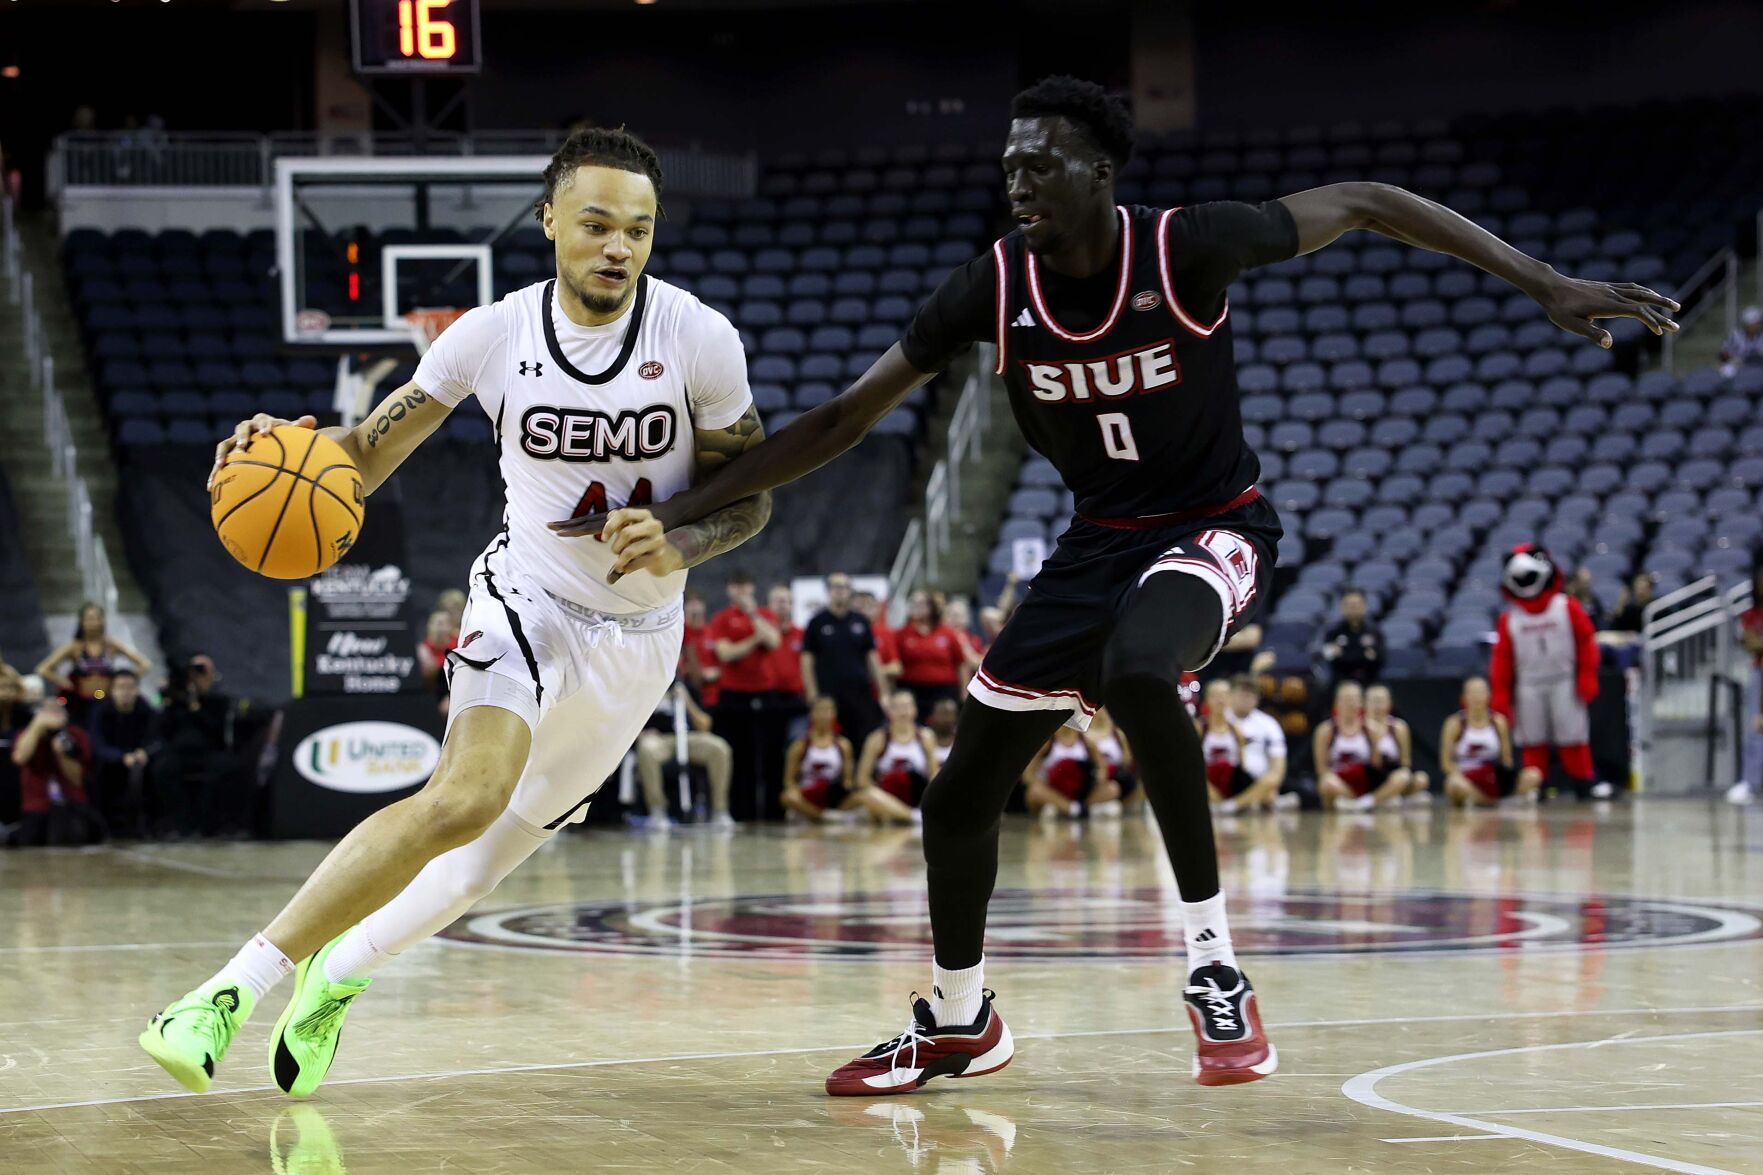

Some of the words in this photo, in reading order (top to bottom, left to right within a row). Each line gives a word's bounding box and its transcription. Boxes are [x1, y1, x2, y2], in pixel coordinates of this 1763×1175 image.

[399, 0, 456, 58] 16
[640, 364, 661, 377] OVC
[1024, 341, 1179, 402] SIUE
[522, 405, 676, 462] SEMO
[1096, 412, 1140, 461] 0
